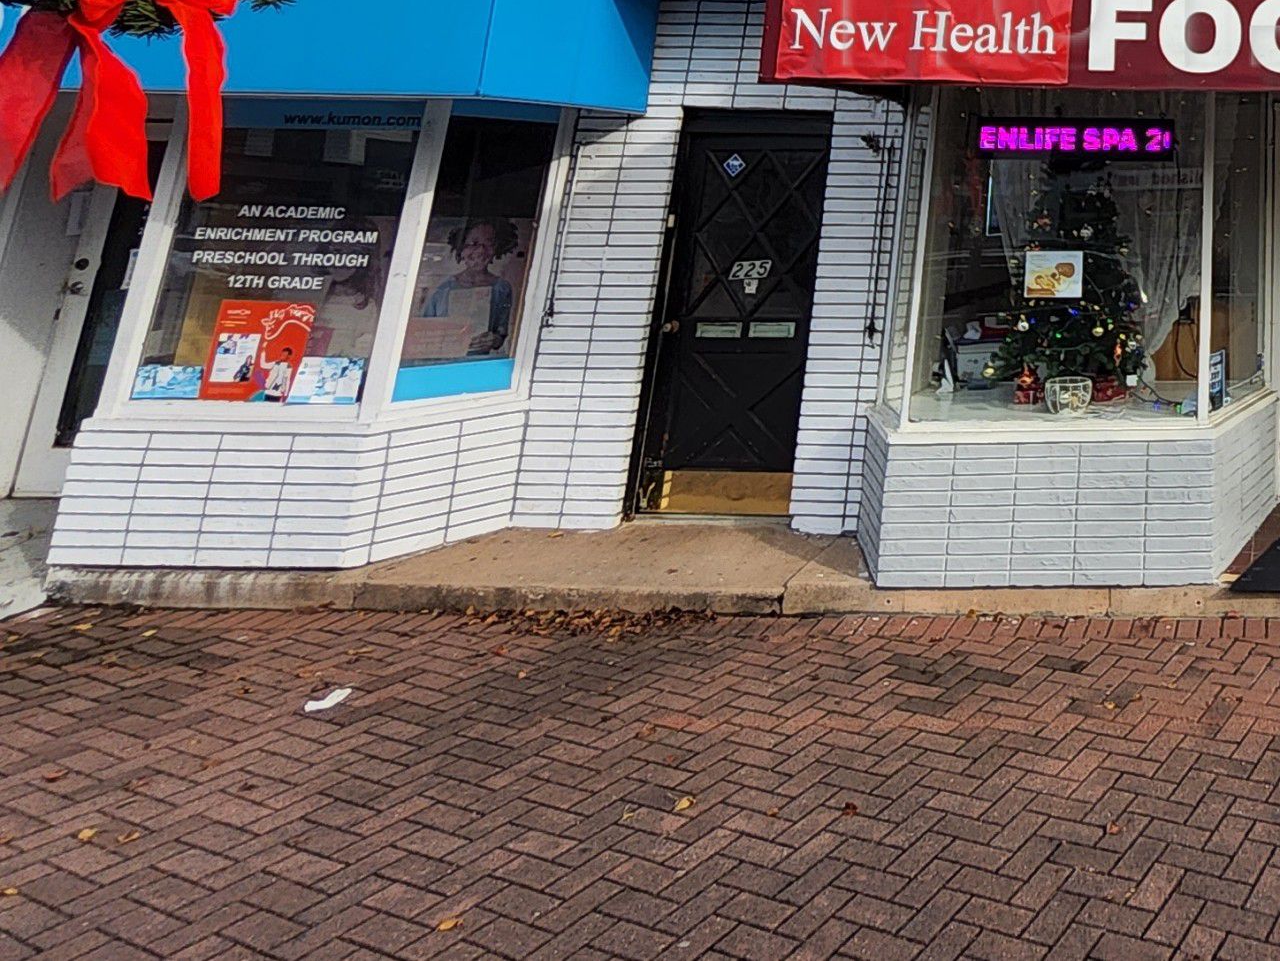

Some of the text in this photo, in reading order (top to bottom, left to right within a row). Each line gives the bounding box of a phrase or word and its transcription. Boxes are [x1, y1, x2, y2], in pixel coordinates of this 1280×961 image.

[790, 8, 1056, 55] New Health
[284, 111, 422, 127] www.kumon.com
[980, 126, 1077, 150] ENLIFE
[1083, 128, 1138, 151] SPA
[238, 205, 345, 219] AN ACADEMIC
[195, 227, 379, 244] ENRICHMENT PROGRAM
[192, 251, 369, 267] PRESCHOOL THROUGH
[732, 262, 770, 278] 225
[227, 275, 324, 289] 12TH GRADE
